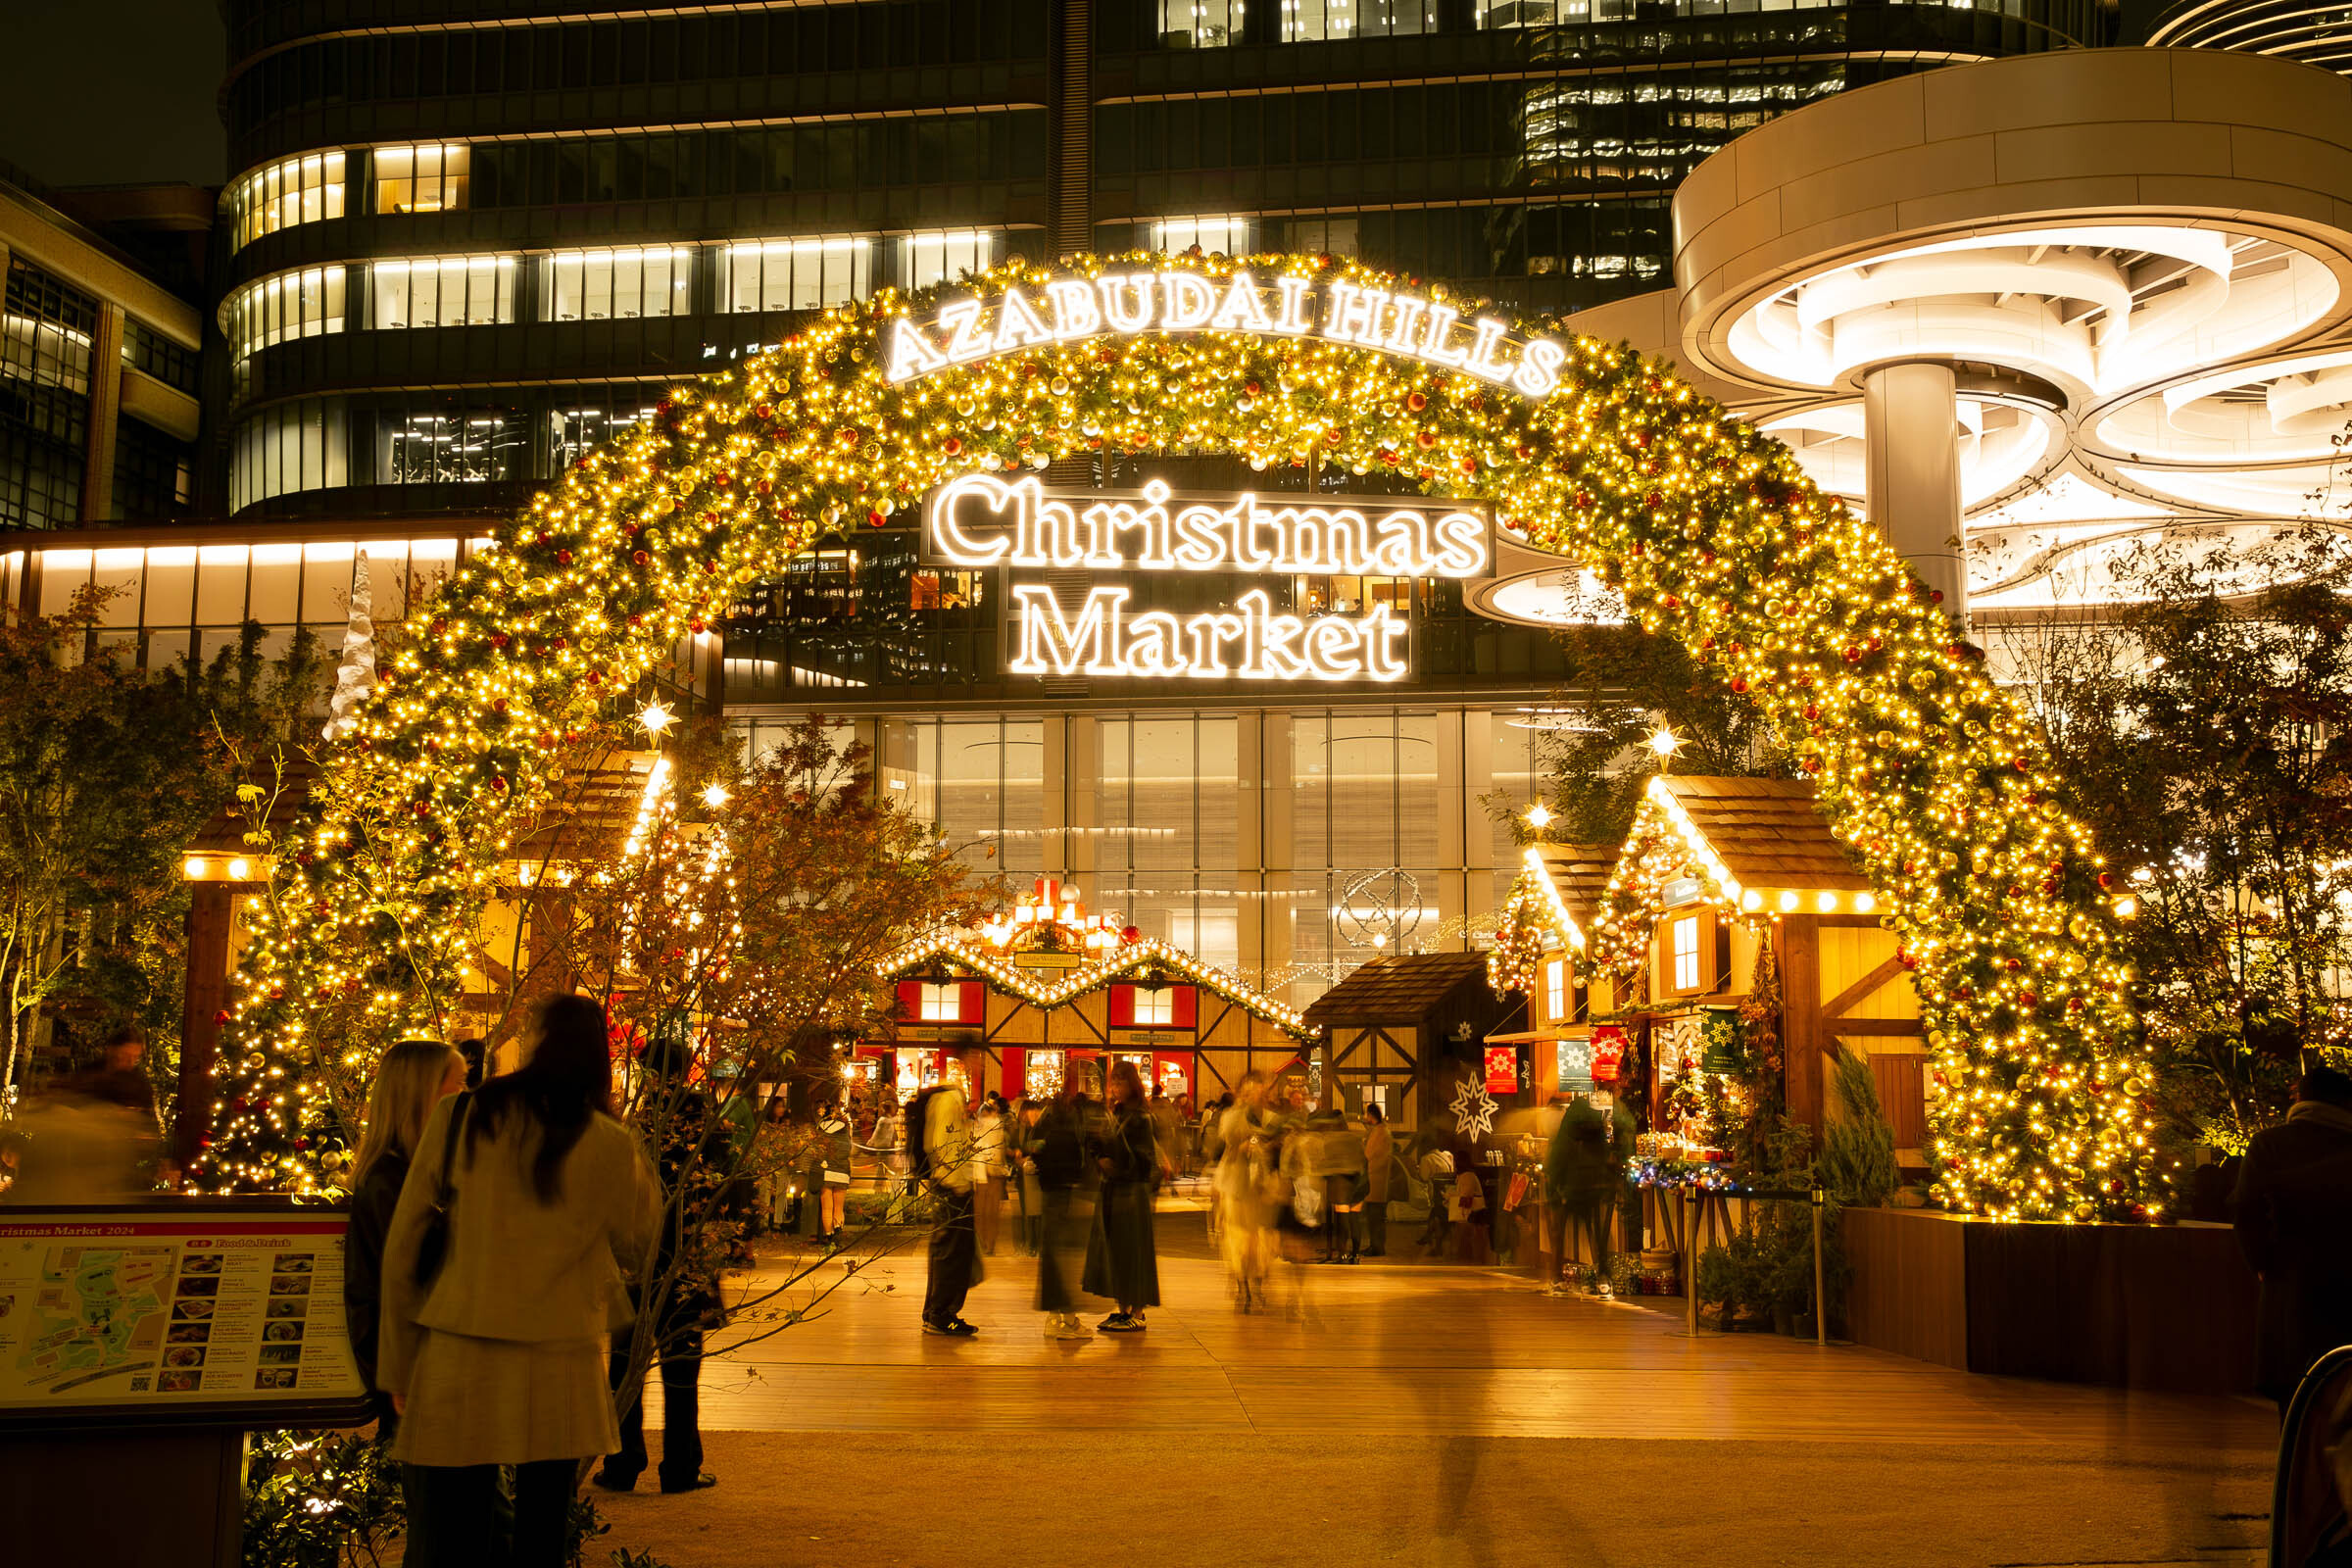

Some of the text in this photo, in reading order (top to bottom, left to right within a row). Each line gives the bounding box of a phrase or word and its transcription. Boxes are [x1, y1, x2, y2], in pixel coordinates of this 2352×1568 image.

[887, 271, 1568, 397] AZABUDAI HILLS
[930, 473, 1489, 578] Christmas
[1011, 584, 1409, 682] Market
[54, 1226, 102, 1236] Market
[107, 1226, 134, 1235] 2024
[216, 1239, 244, 1248] Food
[258, 1239, 291, 1248] Drink
